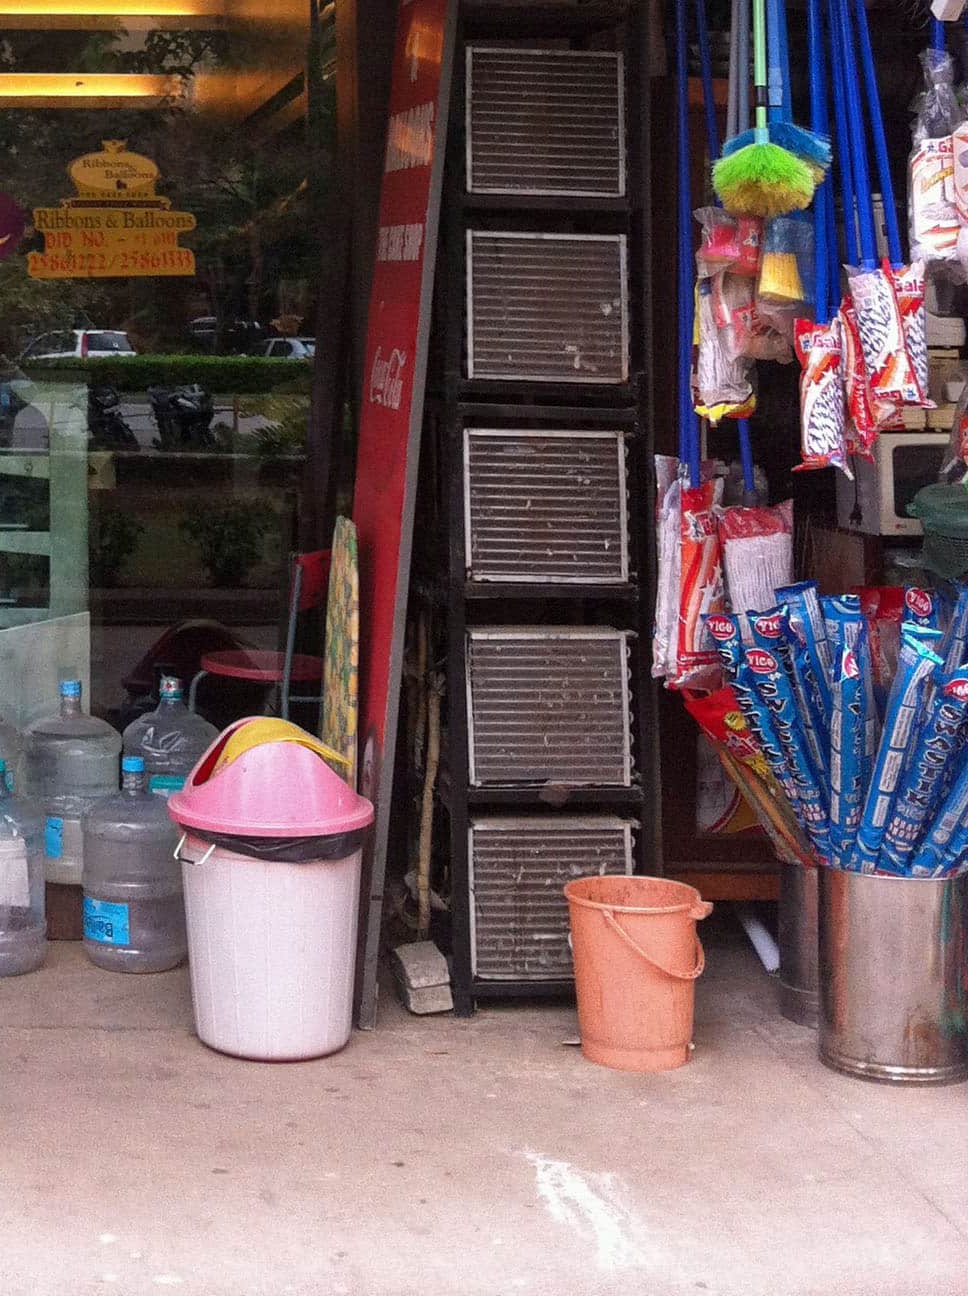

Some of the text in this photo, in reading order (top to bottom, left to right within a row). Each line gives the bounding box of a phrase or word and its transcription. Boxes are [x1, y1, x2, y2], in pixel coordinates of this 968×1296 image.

[37, 210, 194, 229] Ribbons & Balloons
